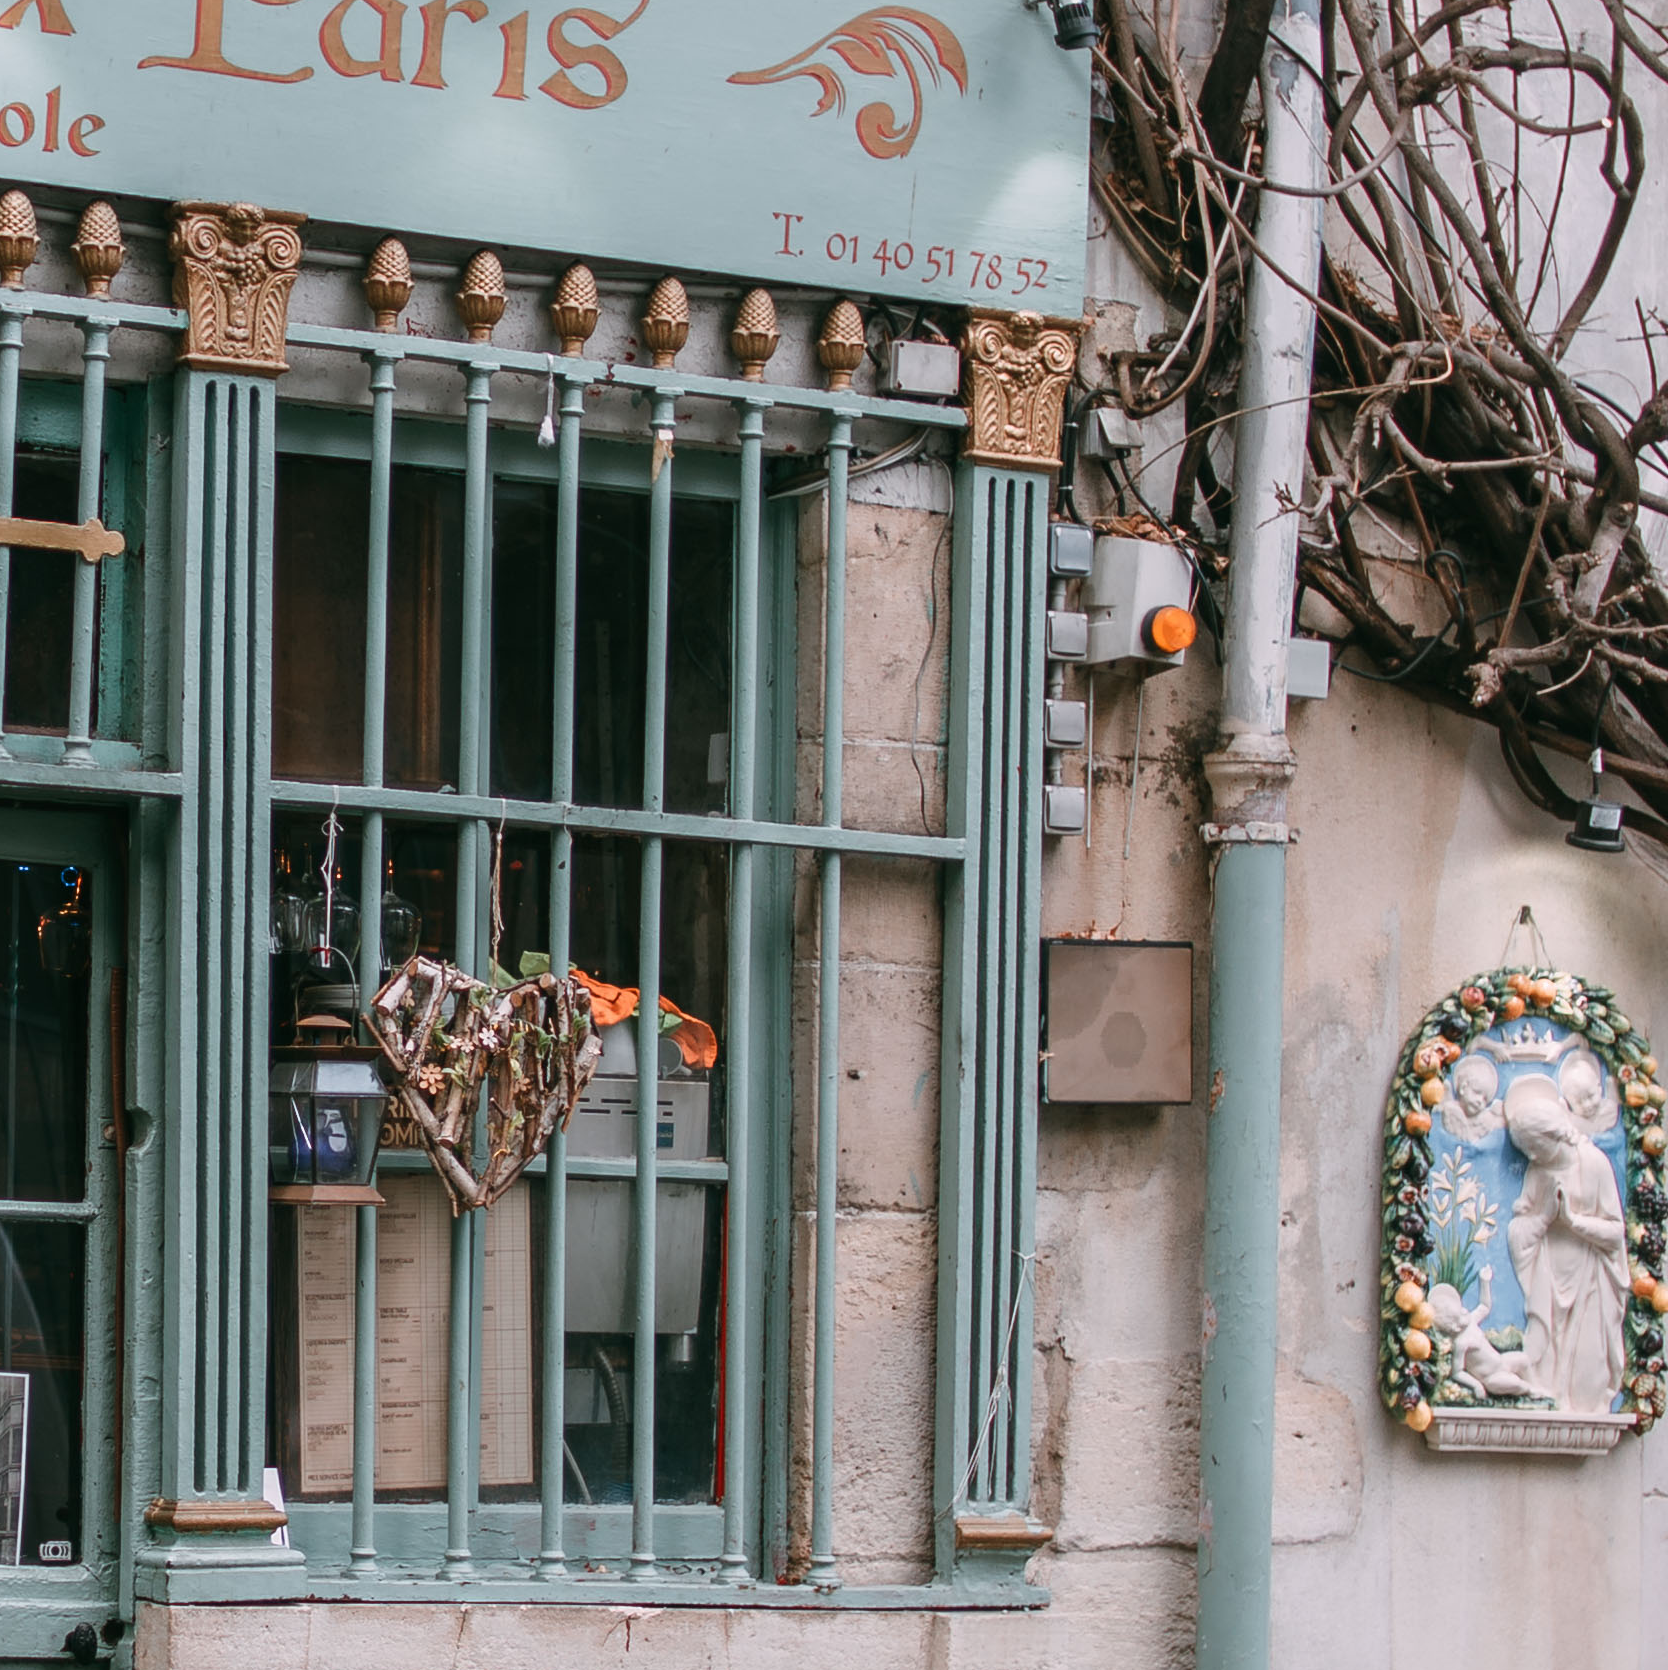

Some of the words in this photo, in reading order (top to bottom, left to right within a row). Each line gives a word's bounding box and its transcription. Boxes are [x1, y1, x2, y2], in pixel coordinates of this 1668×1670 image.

[772, 212, 804, 258] T.
[826, 233, 859, 264] 01
[873, 238, 914, 277] 40
[921, 246, 955, 283] 51
[969, 251, 1003, 289] 78
[1011, 258, 1049, 295] 52
